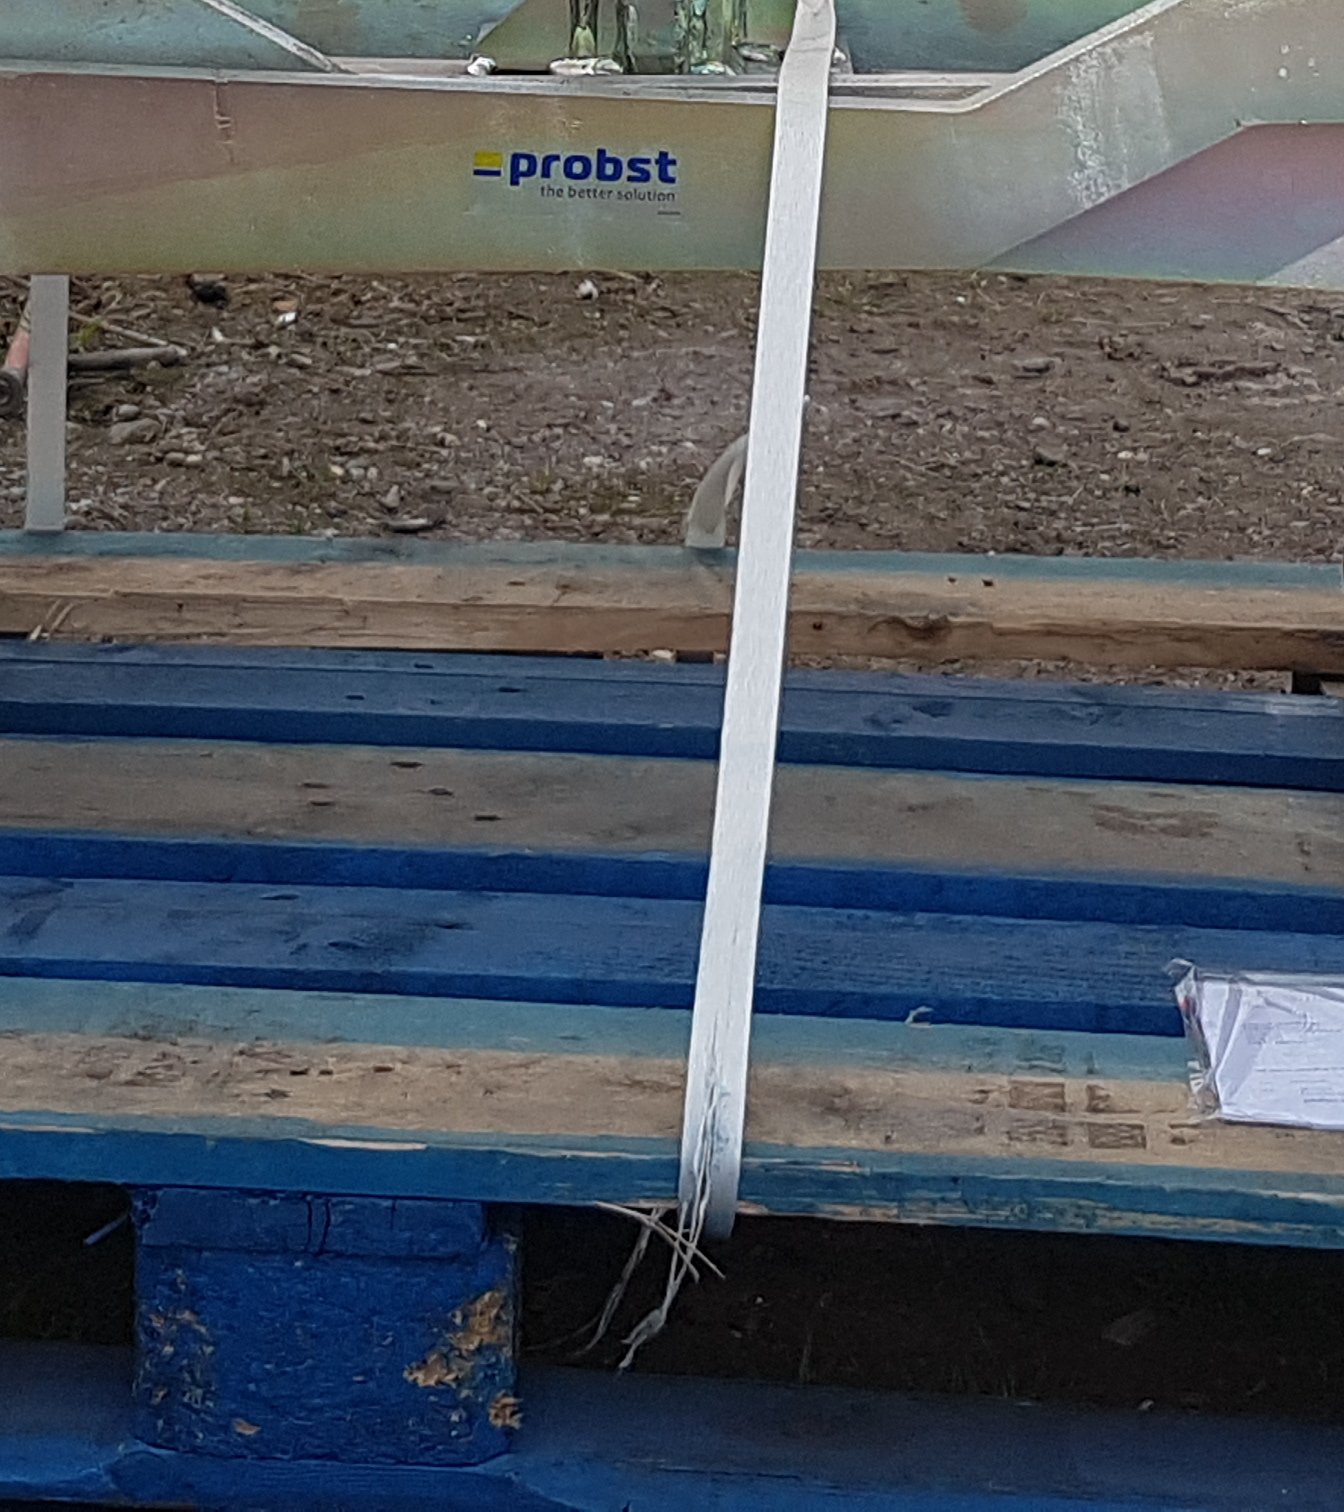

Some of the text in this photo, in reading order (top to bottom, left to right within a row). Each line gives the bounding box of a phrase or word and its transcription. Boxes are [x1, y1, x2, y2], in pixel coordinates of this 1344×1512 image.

[510, 148, 677, 186] probst
[540, 184, 676, 202] the better solution
